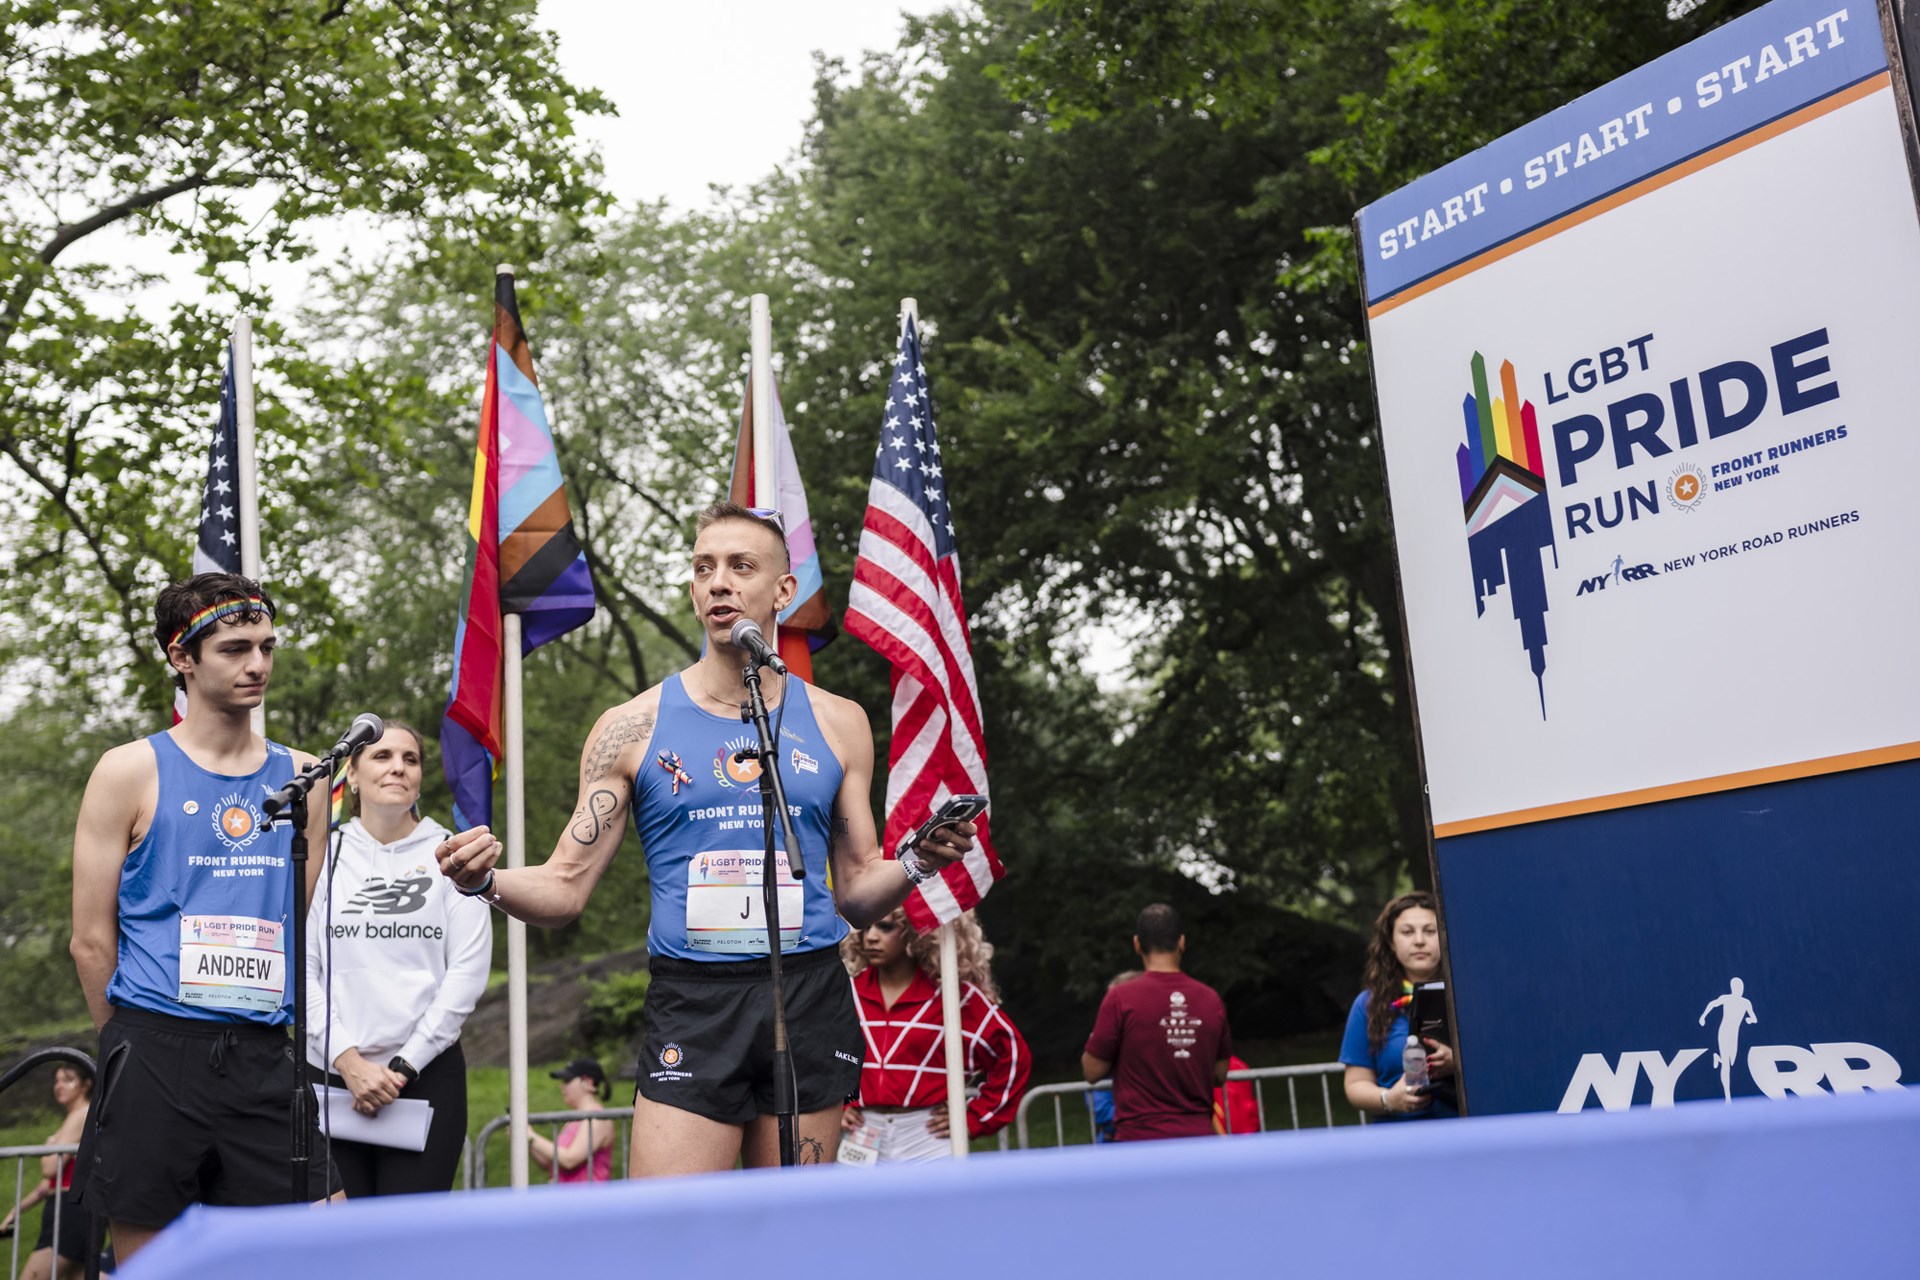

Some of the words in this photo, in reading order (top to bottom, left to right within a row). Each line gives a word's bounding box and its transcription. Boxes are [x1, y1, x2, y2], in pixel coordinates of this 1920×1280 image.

[1379, 183, 1488, 260] START
[1525, 103, 1653, 190] START
[1695, 9, 1849, 108] START
[1544, 333, 1654, 405] LGBT
[1552, 327, 1840, 488] PRIDE
[1711, 451, 1764, 478] FRONT
[1767, 425, 1848, 461] RUNNERS
[1714, 473, 1744, 492] NEW
[1745, 464, 1781, 484] YORK
[1565, 480, 1660, 539] RUN
[1664, 555, 1696, 573] NEW
[1699, 543, 1738, 564] YORK
[1742, 531, 1784, 553] ROAD
[1788, 511, 1860, 540] RUNNERS
[688, 806, 734, 821] FRONT
[738, 804, 802, 817] RUNRS
[719, 821, 744, 830] NEW
[188, 856, 227, 867] FRONT
[230, 856, 285, 868] RUNNERS
[213, 868, 236, 878] NEW
[238, 867, 264, 877] YORK
[711, 858, 736, 866] LGBT
[740, 896, 750, 919] J
[204, 922, 228, 930] LGBT
[230, 923, 257, 932] PRIDE
[258, 926, 275, 935] RUN
[365, 921, 443, 939] balance
[197, 953, 271, 981] ANDREW
